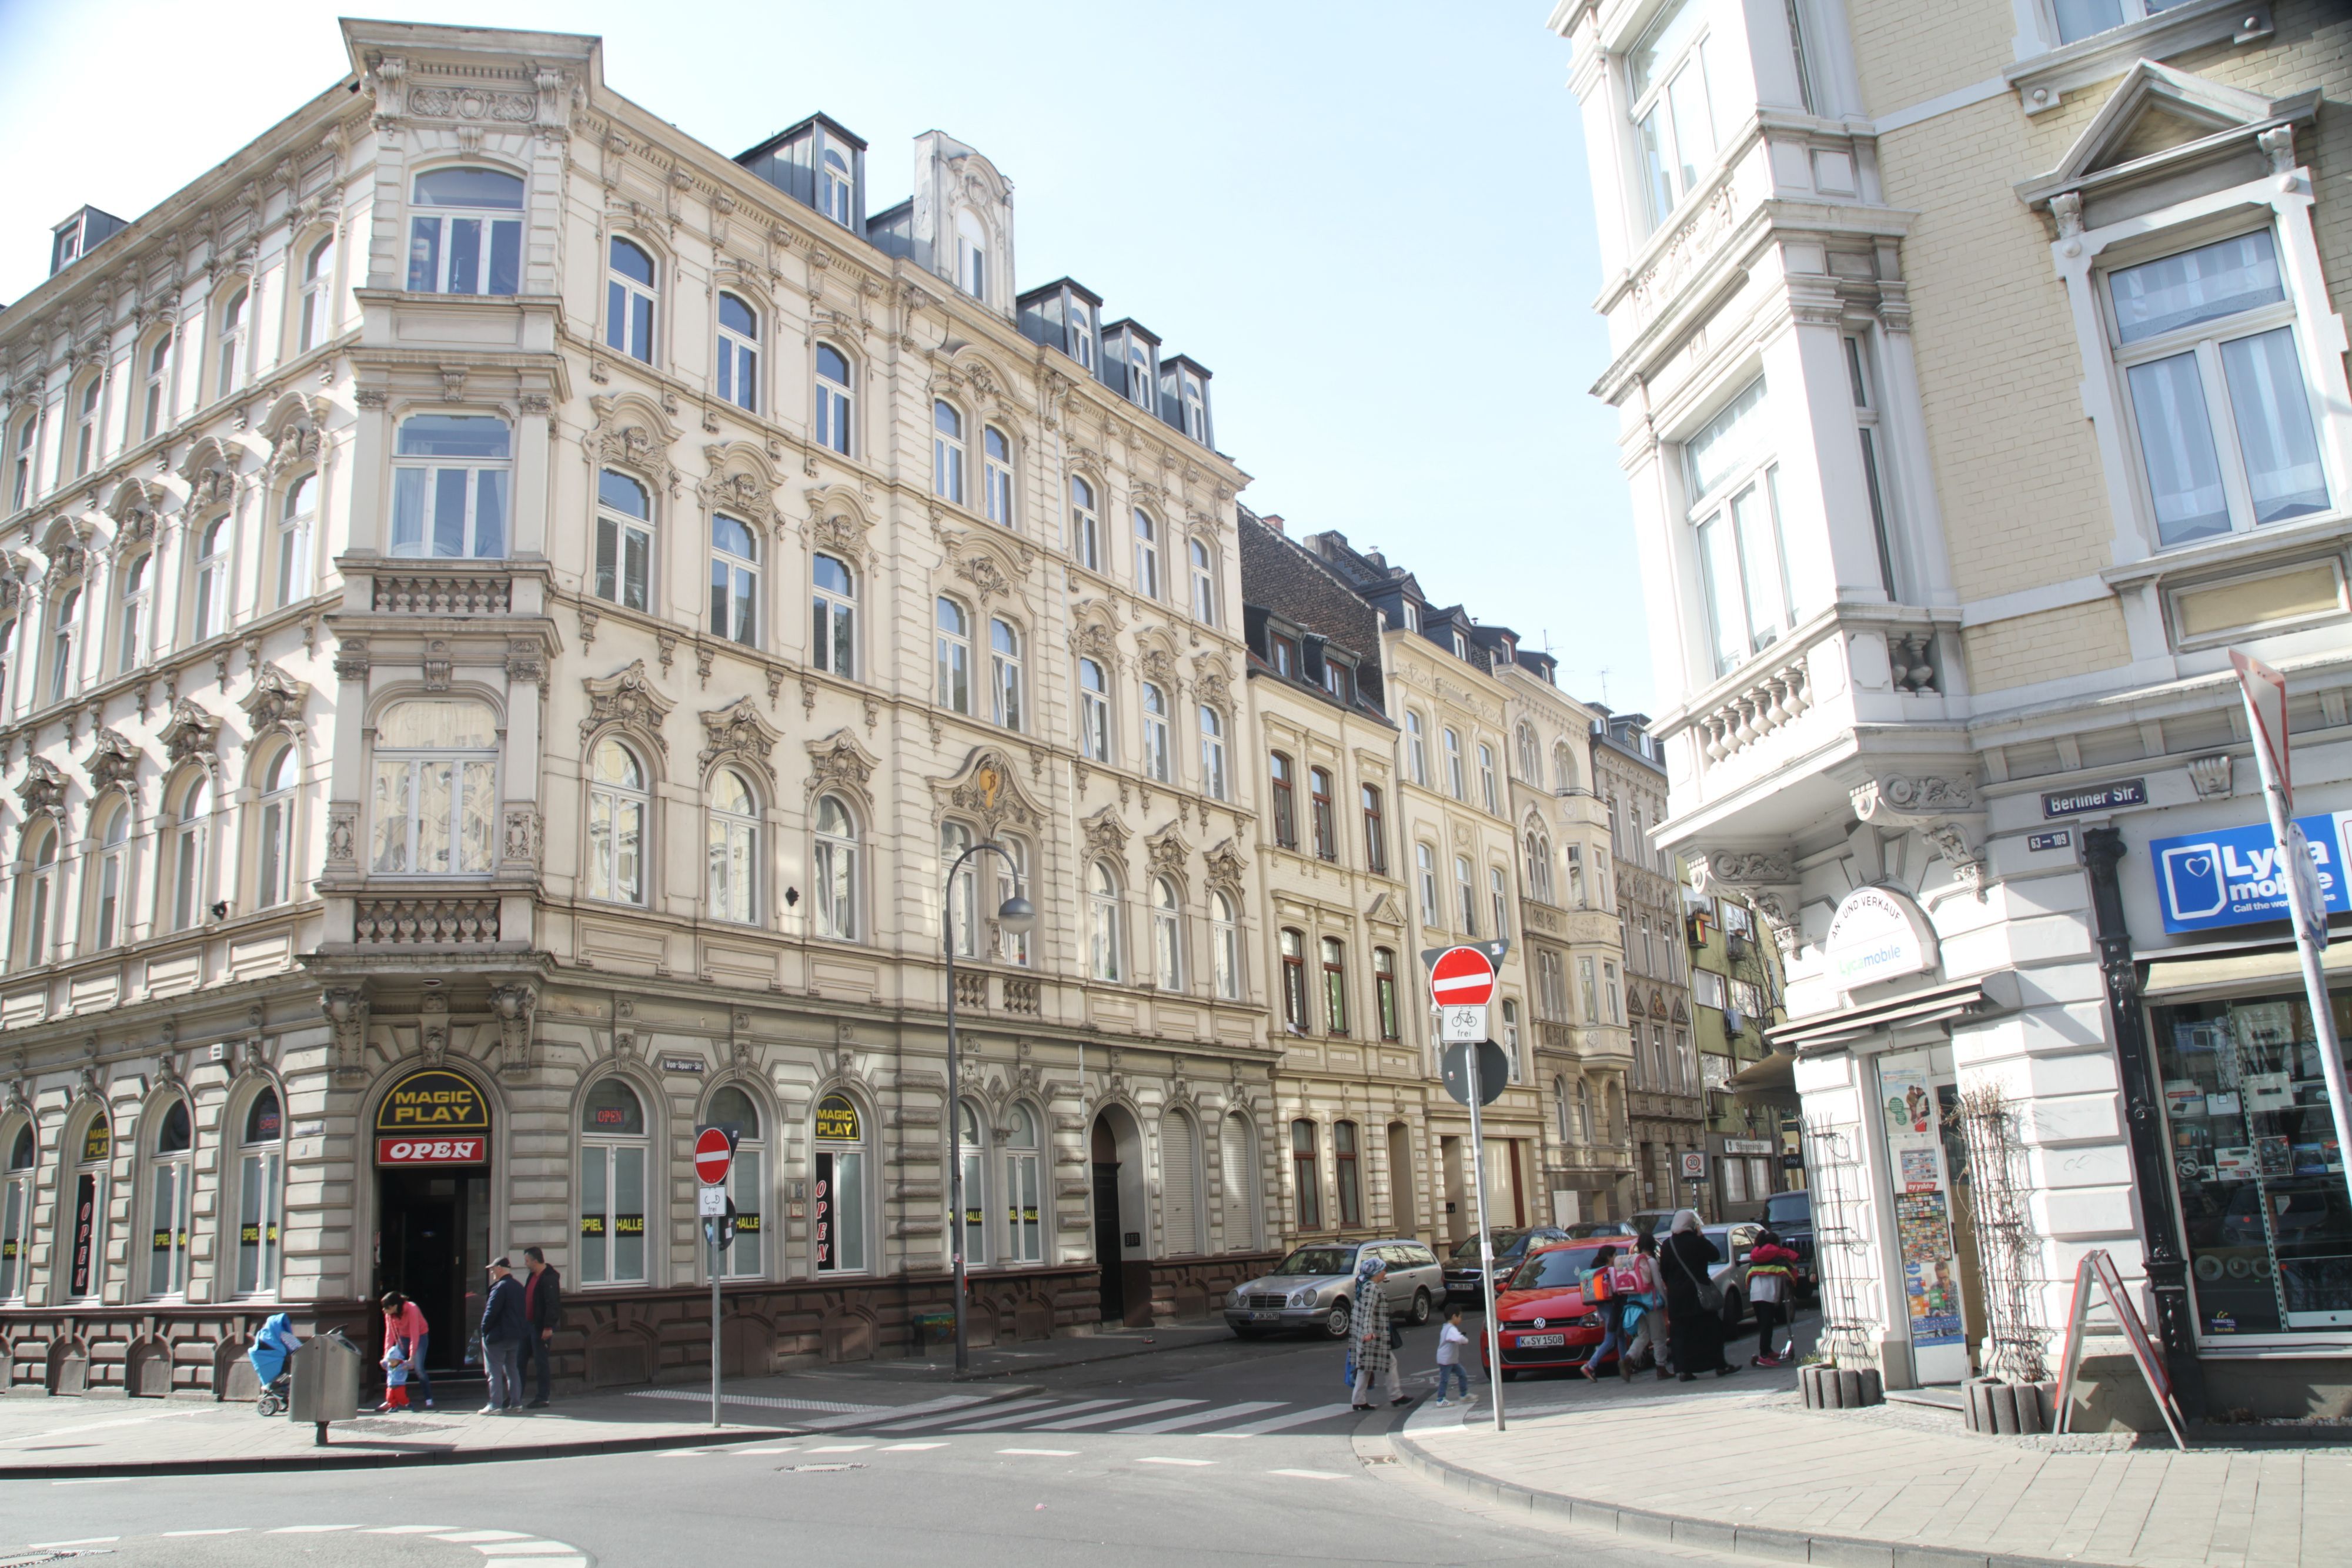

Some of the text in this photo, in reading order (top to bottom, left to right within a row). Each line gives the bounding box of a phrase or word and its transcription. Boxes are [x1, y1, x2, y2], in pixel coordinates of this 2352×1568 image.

[2051, 785, 2139, 812] Berliner Str.
[2030, 833, 2067, 849] 63 109
[1842, 900, 1859, 918] UND
[1861, 896, 1901, 920] VERKAUF
[2233, 902, 2252, 912] Call
[2253, 901, 2270, 910] the
[2269, 900, 2289, 908] wor
[1458, 1029, 1471, 1037] frei
[666, 1060, 703, 1070] Von-Sparr-Str.
[395, 1091, 472, 1104] MAGIC
[395, 1106, 472, 1122] PLAY
[597, 1111, 622, 1123] OPEN
[817, 1109, 853, 1121] MAGIC
[259, 1119, 279, 1129] OPEN
[817, 1122, 853, 1135] PLAY
[88, 1128, 109, 1140] MAG
[88, 1141, 109, 1155] PLA
[390, 1142, 476, 1159] OPEN
[1785, 1157, 1798, 1165] sky
[580, 1218, 643, 1231] SPIEL HALLE
[736, 1216, 759, 1229] HALLE
[816, 1180, 828, 1262] OPEN
[155, 1233, 171, 1246] SPIEL
[242, 1228, 260, 1241] SPIEL
[75, 1202, 91, 1287] OPEN
[1531, 1336, 1541, 1345] SY
[1543, 1335, 1562, 1345] 1508
